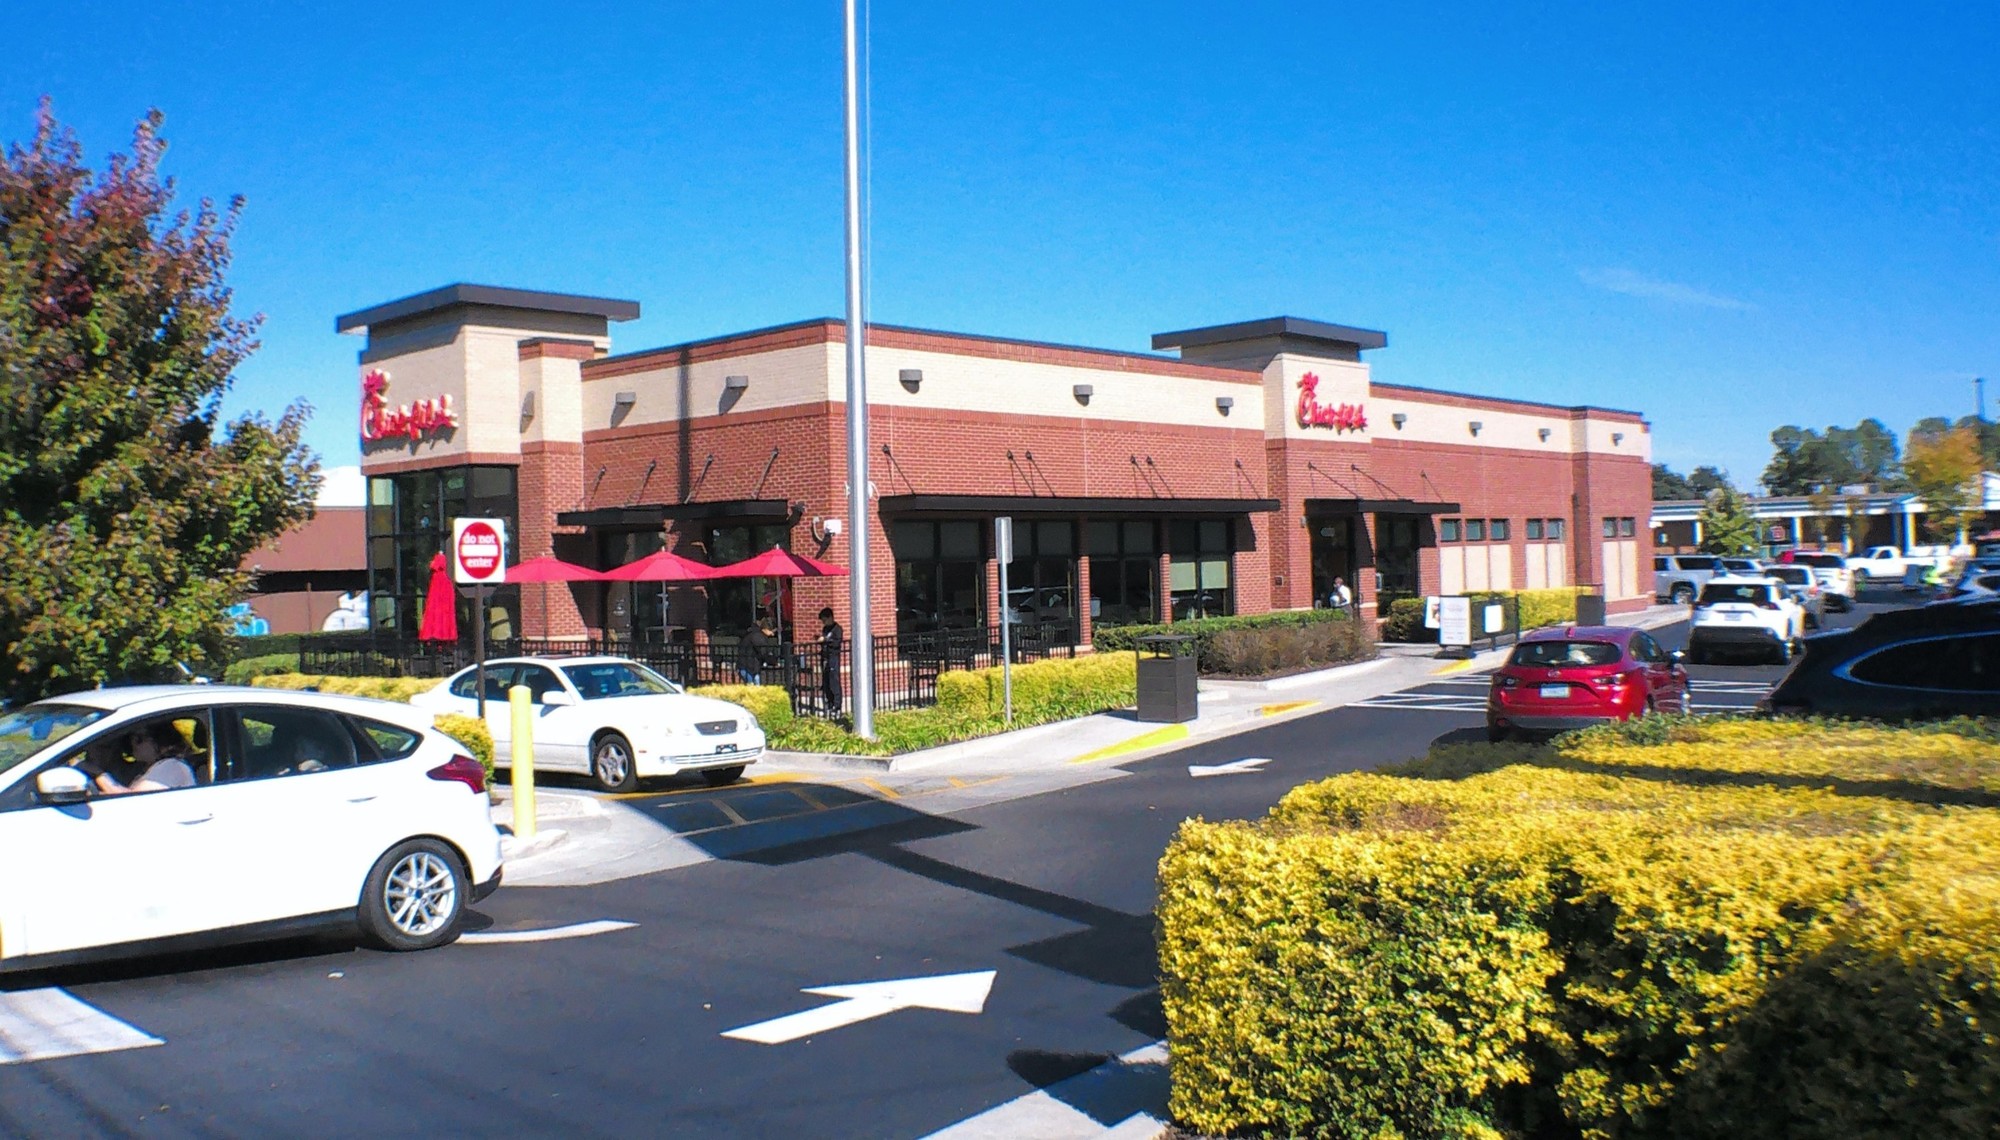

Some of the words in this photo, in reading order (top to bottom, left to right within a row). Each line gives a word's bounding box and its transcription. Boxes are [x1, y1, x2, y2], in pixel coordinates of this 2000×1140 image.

[463, 532, 477, 544] do
[478, 533, 496, 544] not
[466, 557, 494, 568] enter
